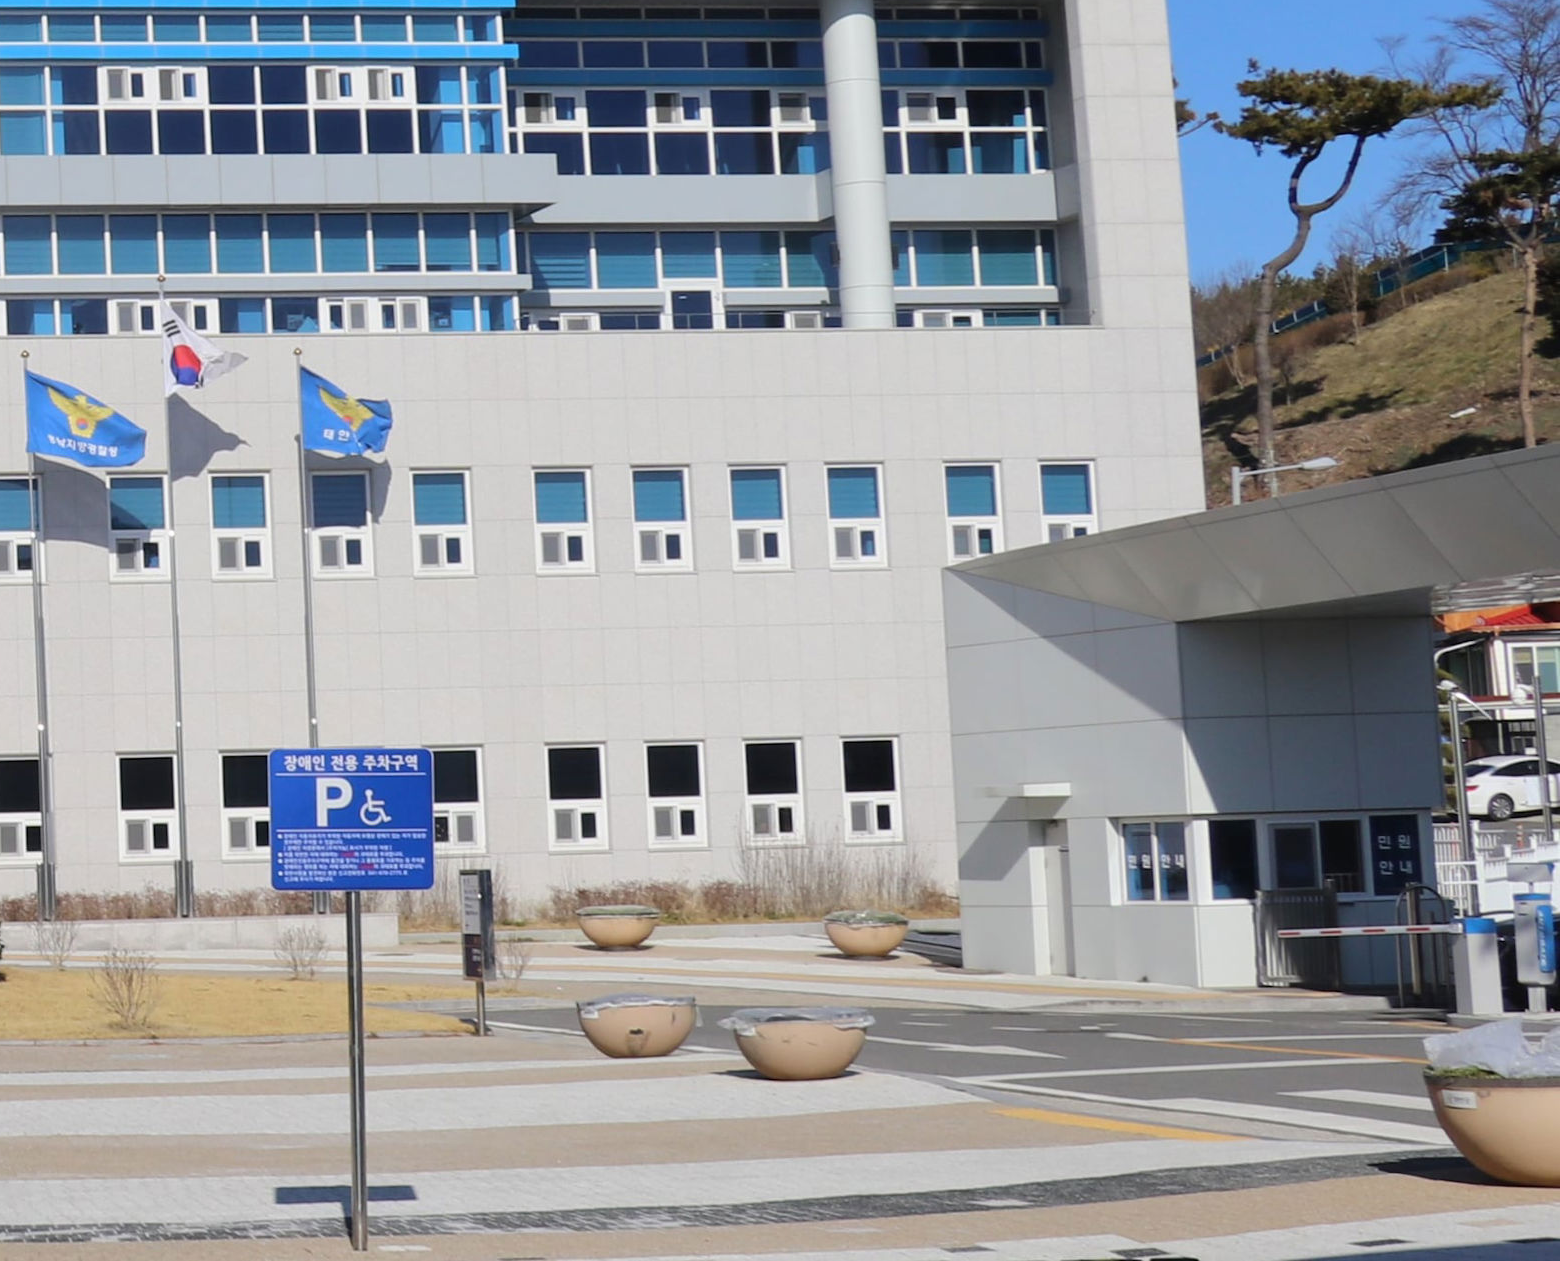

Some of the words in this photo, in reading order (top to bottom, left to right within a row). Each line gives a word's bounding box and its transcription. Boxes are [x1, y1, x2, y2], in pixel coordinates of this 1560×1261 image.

[283, 754, 326, 772] 장애인
[330, 754, 359, 772] 전용
[363, 754, 419, 772] 주차구역
[316, 777, 353, 828] P
[1379, 860, 1414, 876] 안내
